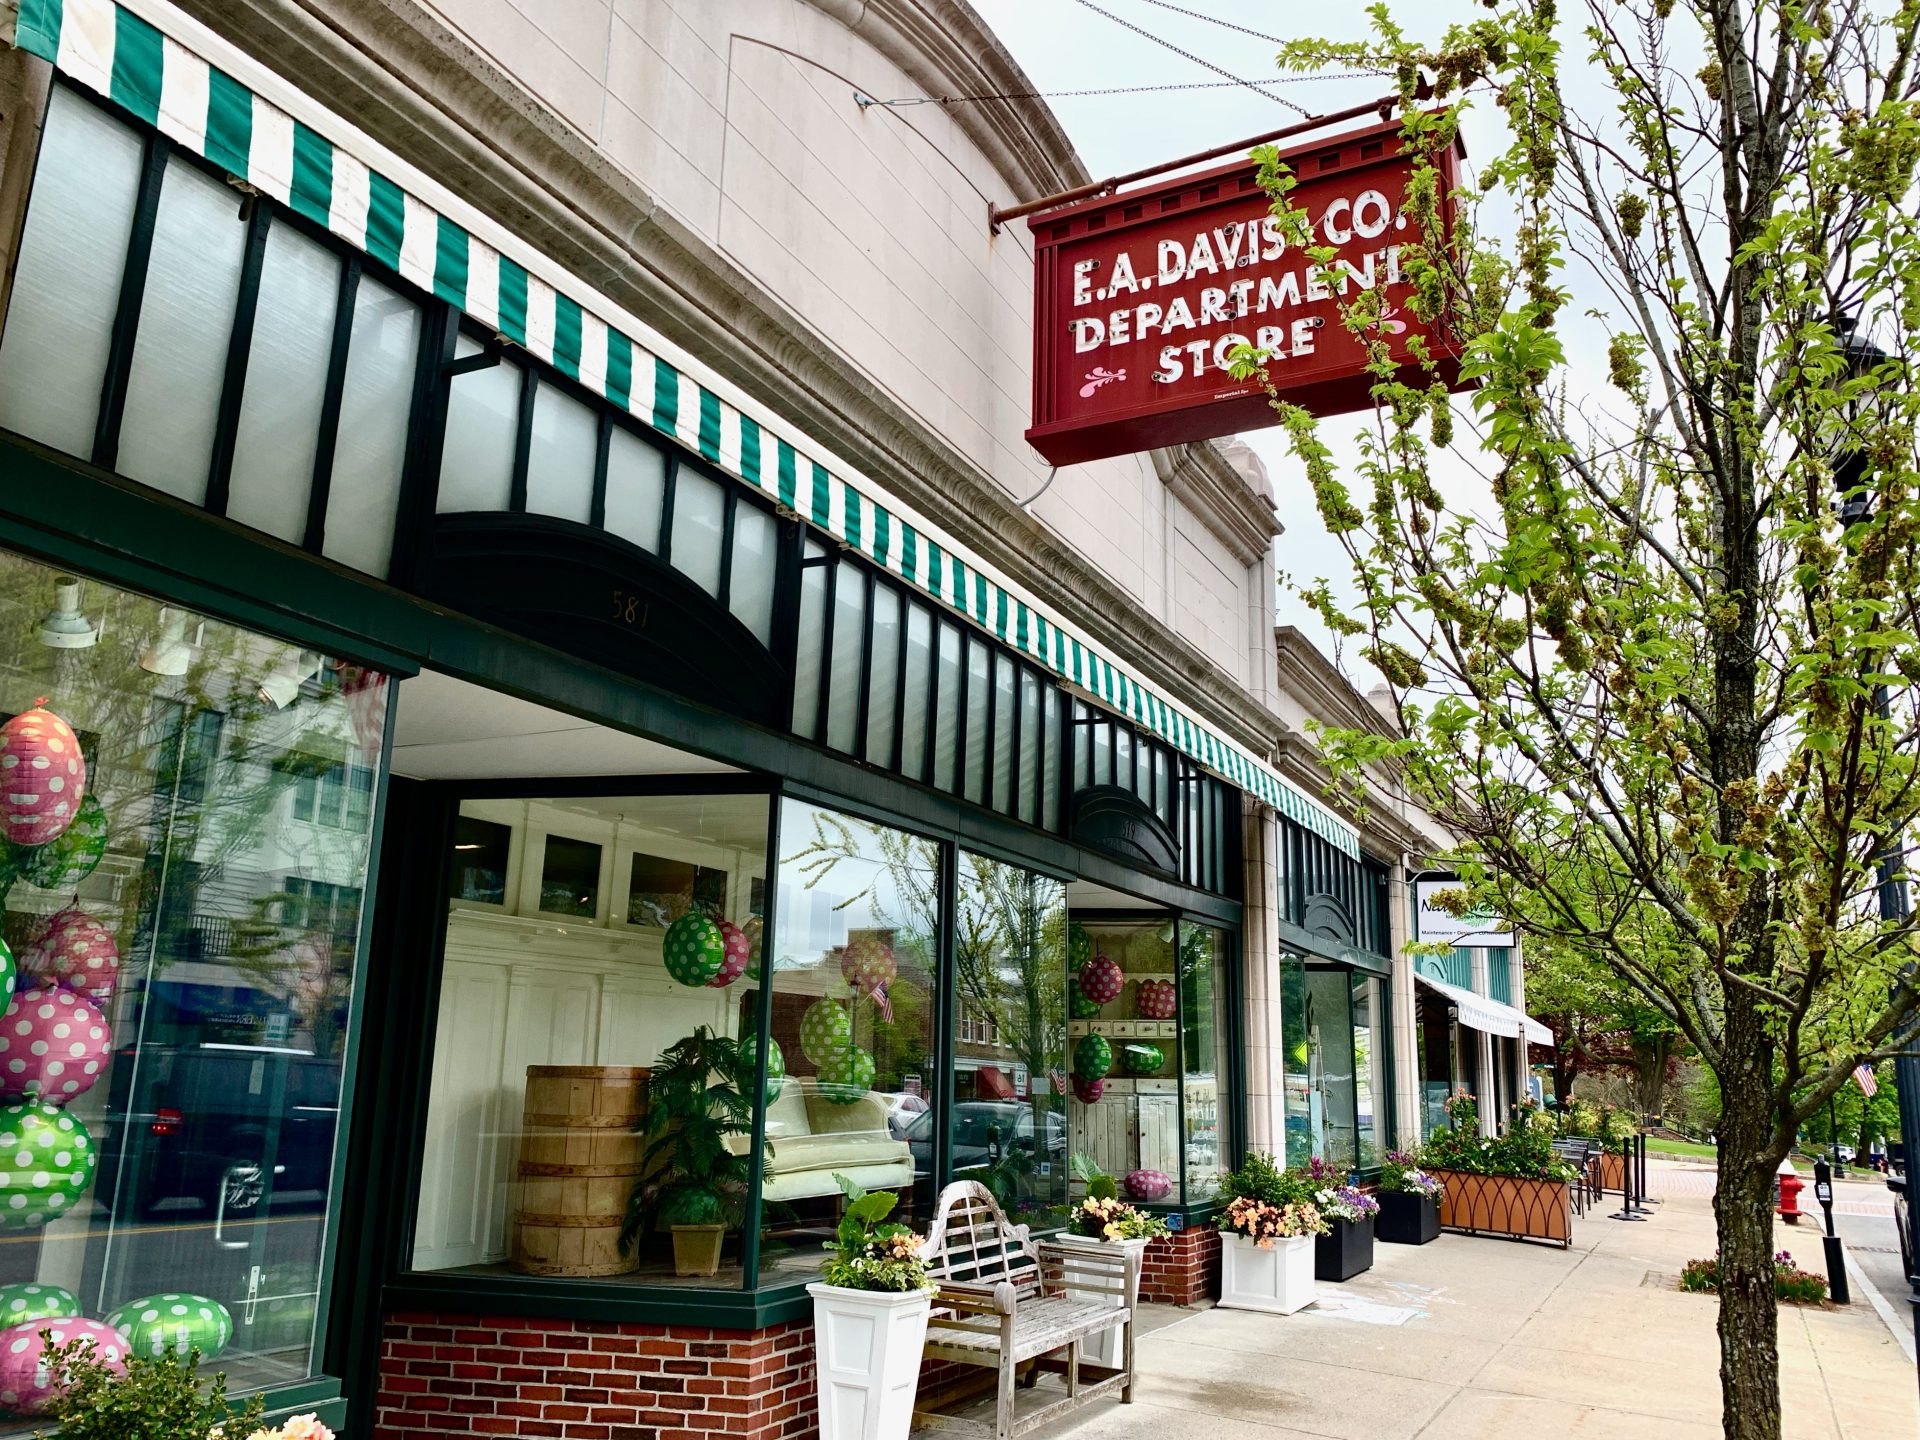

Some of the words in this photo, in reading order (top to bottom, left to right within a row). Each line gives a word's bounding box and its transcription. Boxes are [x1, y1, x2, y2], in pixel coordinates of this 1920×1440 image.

[1074, 245, 1404, 353] DEPARTMENT
[1156, 317, 1315, 383] STORE
[612, 590, 648, 628] 581
